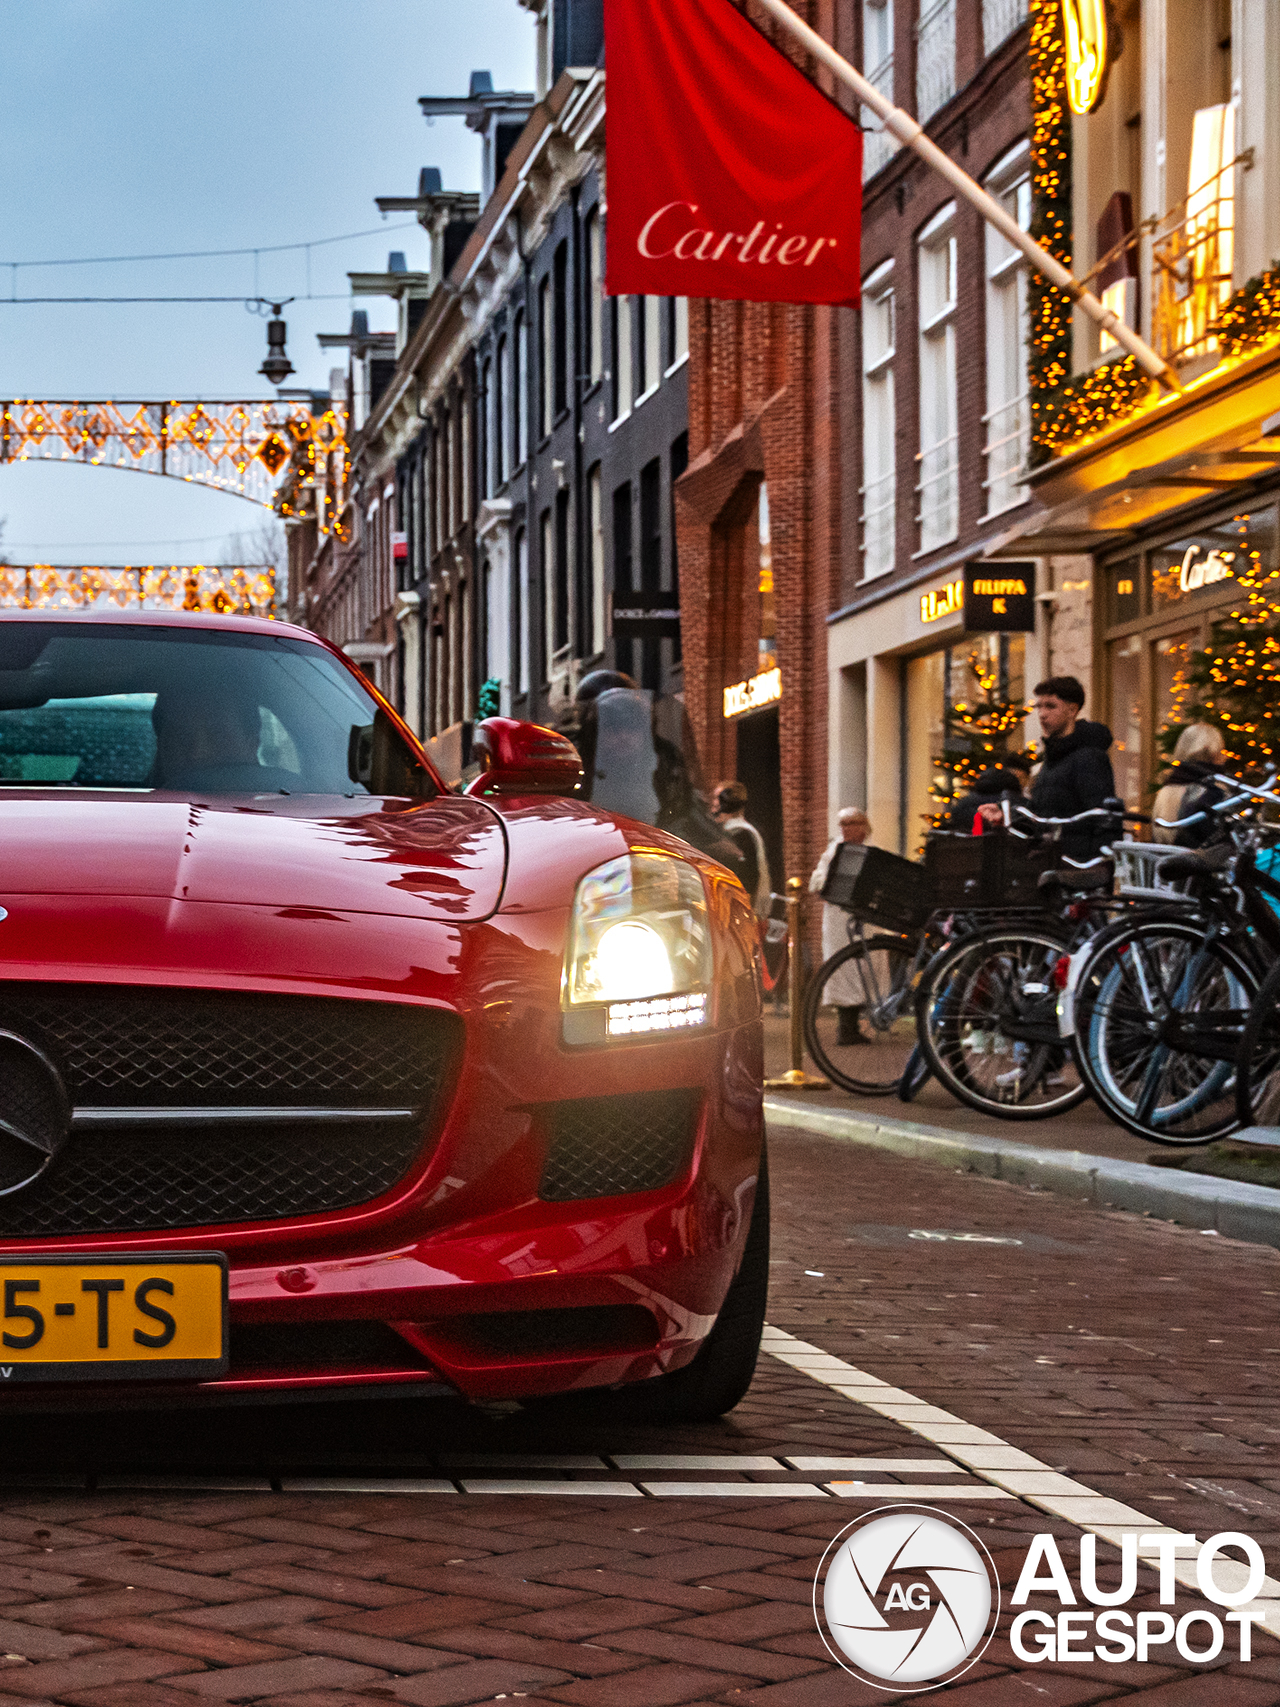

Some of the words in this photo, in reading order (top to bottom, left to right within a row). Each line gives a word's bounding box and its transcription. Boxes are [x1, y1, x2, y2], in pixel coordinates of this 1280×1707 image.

[636, 200, 837, 266] Cartier
[972, 578, 1027, 596] FILIPPA
[991, 597, 1007, 614] K
